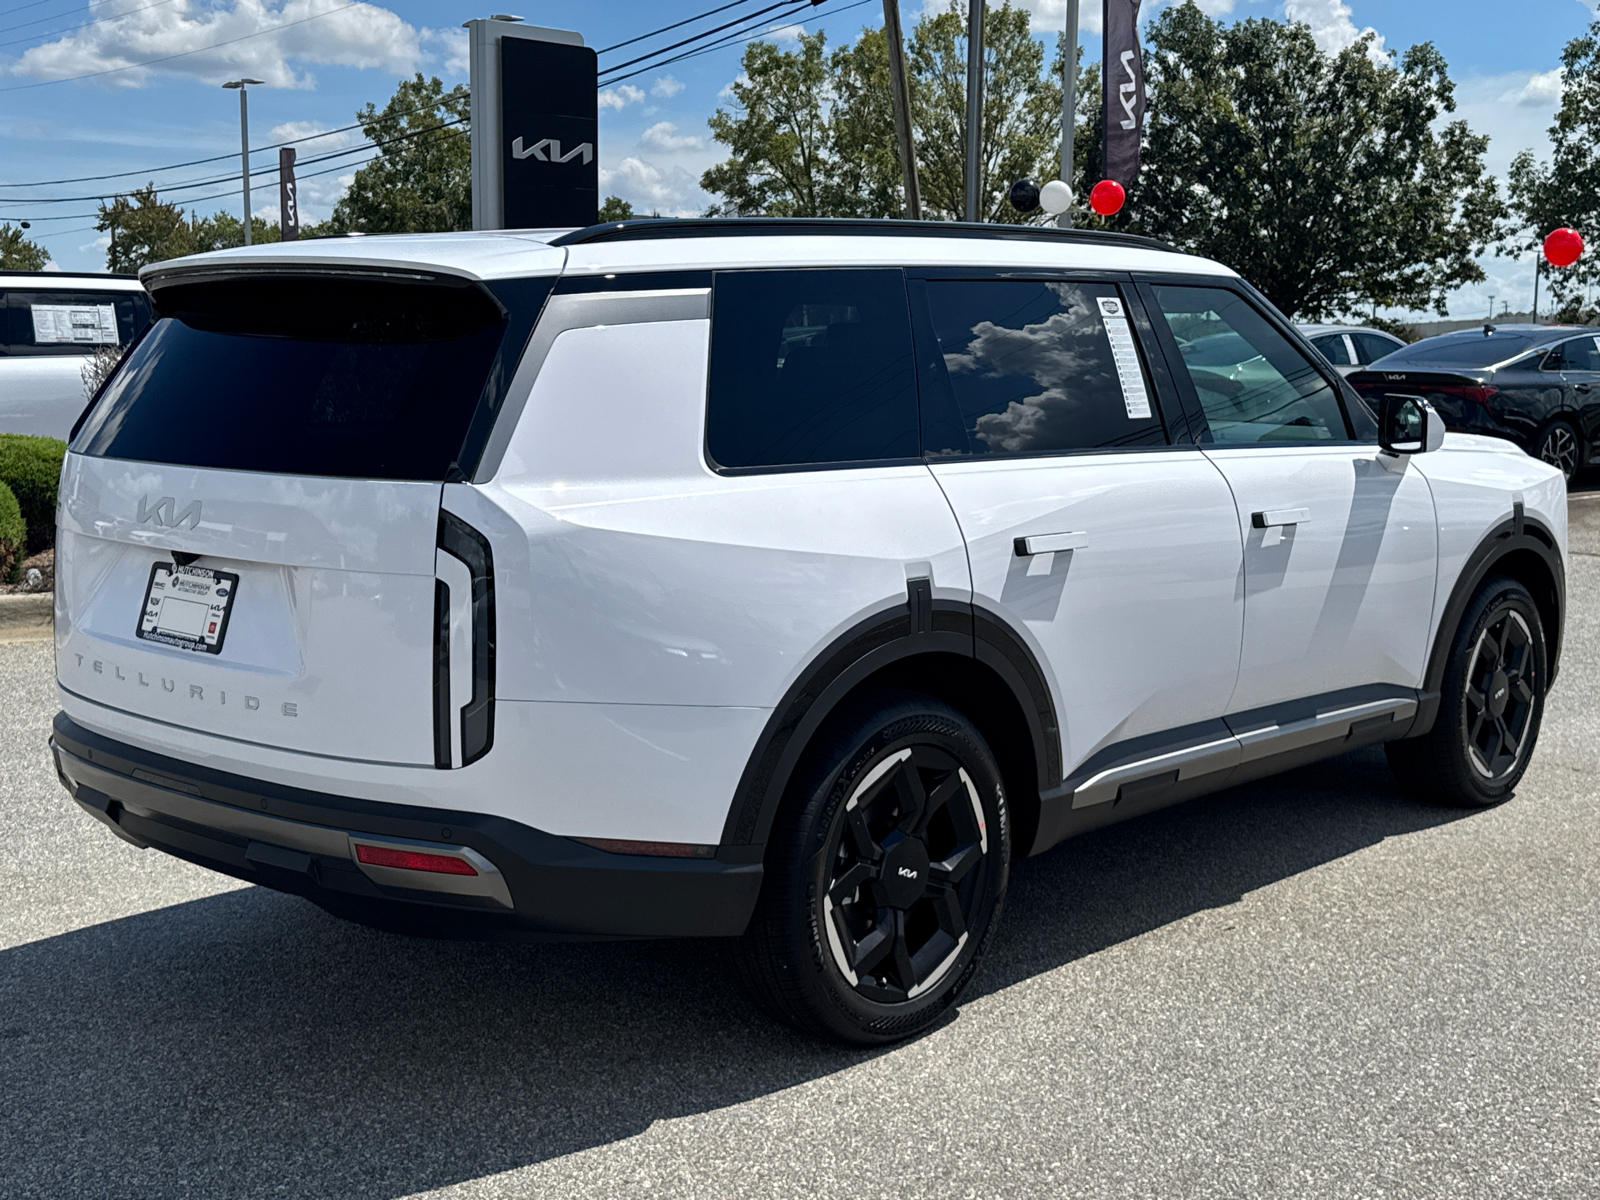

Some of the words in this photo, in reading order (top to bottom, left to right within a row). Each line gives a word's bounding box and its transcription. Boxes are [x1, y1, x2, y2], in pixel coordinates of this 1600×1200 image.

[1119, 49, 1137, 130] KIA
[512, 136, 593, 166] KIA
[286, 182, 295, 227] KIA
[136, 493, 203, 531] KIA
[178, 566, 214, 578] HUTCHINSON
[75, 653, 298, 718] TELLURIDE
[898, 866, 918, 880] KIA
